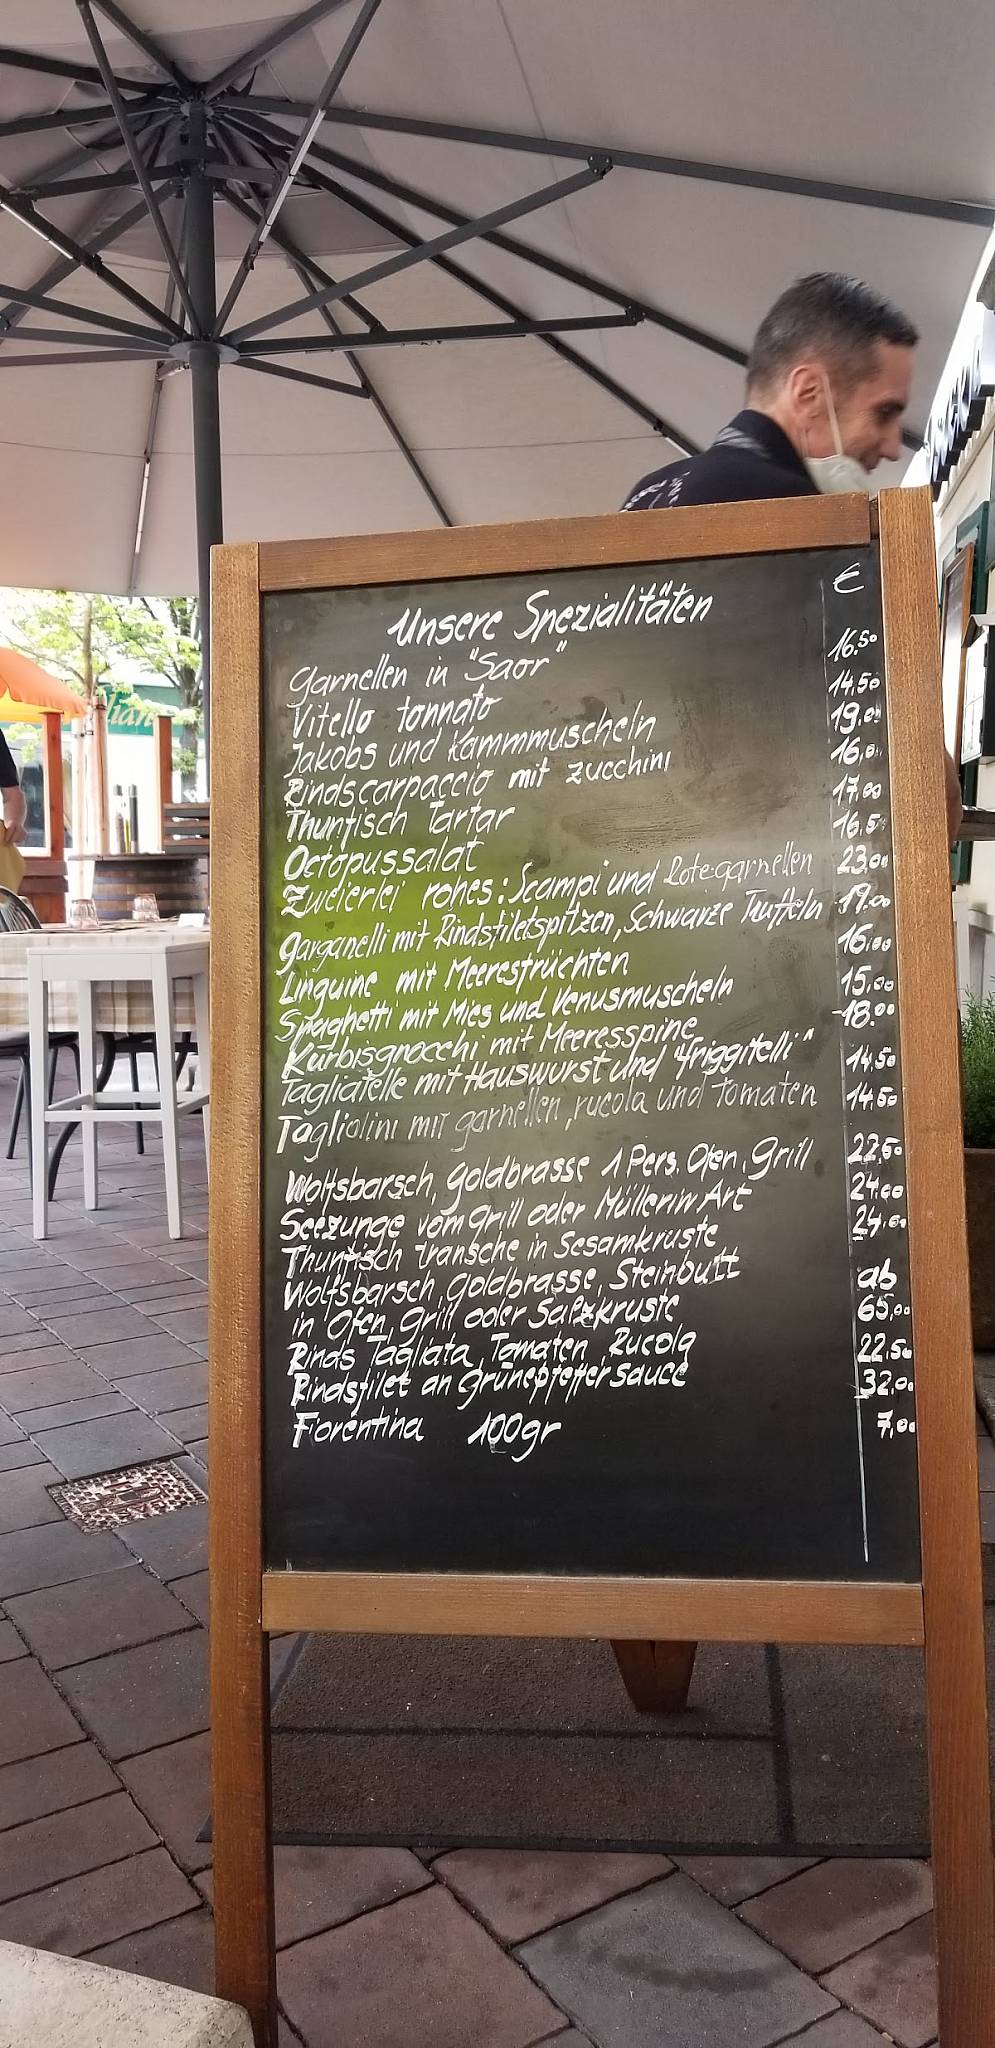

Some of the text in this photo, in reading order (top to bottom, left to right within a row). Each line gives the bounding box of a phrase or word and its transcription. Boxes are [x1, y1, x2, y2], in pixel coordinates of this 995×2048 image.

[833, 562, 865, 594] €
[387, 580, 713, 647] Unsere Spezialitäten
[425, 655, 448, 688] in
[292, 683, 503, 741] Vitello tonnato
[284, 739, 377, 778] Jakobs
[388, 727, 441, 768] und
[284, 762, 495, 815] Rindscarpaccio
[508, 757, 550, 790] mit
[287, 799, 515, 849] Thunfisch Tartar
[282, 835, 485, 888] Octopussalat
[281, 880, 406, 918] Zweierlei
[508, 860, 610, 912] Scampi
[606, 858, 661, 897] und
[391, 918, 431, 954] mit
[274, 963, 735, 1051] Spaghetti mit Mies und Venusmuscheln
[280, 948, 630, 1019] Linguine mit Meeresfrüchten
[489, 1028, 535, 1056] mit
[539, 1016, 698, 1060] Meeresspine
[281, 1067, 408, 1116] Tagliatelle
[413, 1064, 463, 1096] mit
[463, 1049, 612, 1097] Hauswurst
[609, 1044, 668, 1082] und
[276, 1109, 399, 1162] Tagliolini
[408, 1112, 451, 1141] mit
[657, 1072, 708, 1111] und
[601, 1146, 623, 1178] 1
[279, 1207, 405, 1253] Seezunge
[417, 1212, 465, 1239] vom
[527, 1190, 586, 1227] oder
[696, 1178, 752, 1213] Art
[281, 1239, 403, 1283] Thunfisch
[527, 1232, 548, 1262] in
[553, 1215, 719, 1259] Sesamkruste
[609, 1246, 741, 1291] Steinbutt
[857, 1257, 897, 1290] ab
[292, 1312, 314, 1338] in
[463, 1298, 527, 1328] oder
[286, 1340, 356, 1376] Rinds
[608, 1323, 697, 1365] Rucola
[290, 1368, 411, 1418] Rindsfilet
[421, 1374, 452, 1396] an
[292, 1405, 425, 1448] Fiorentina
